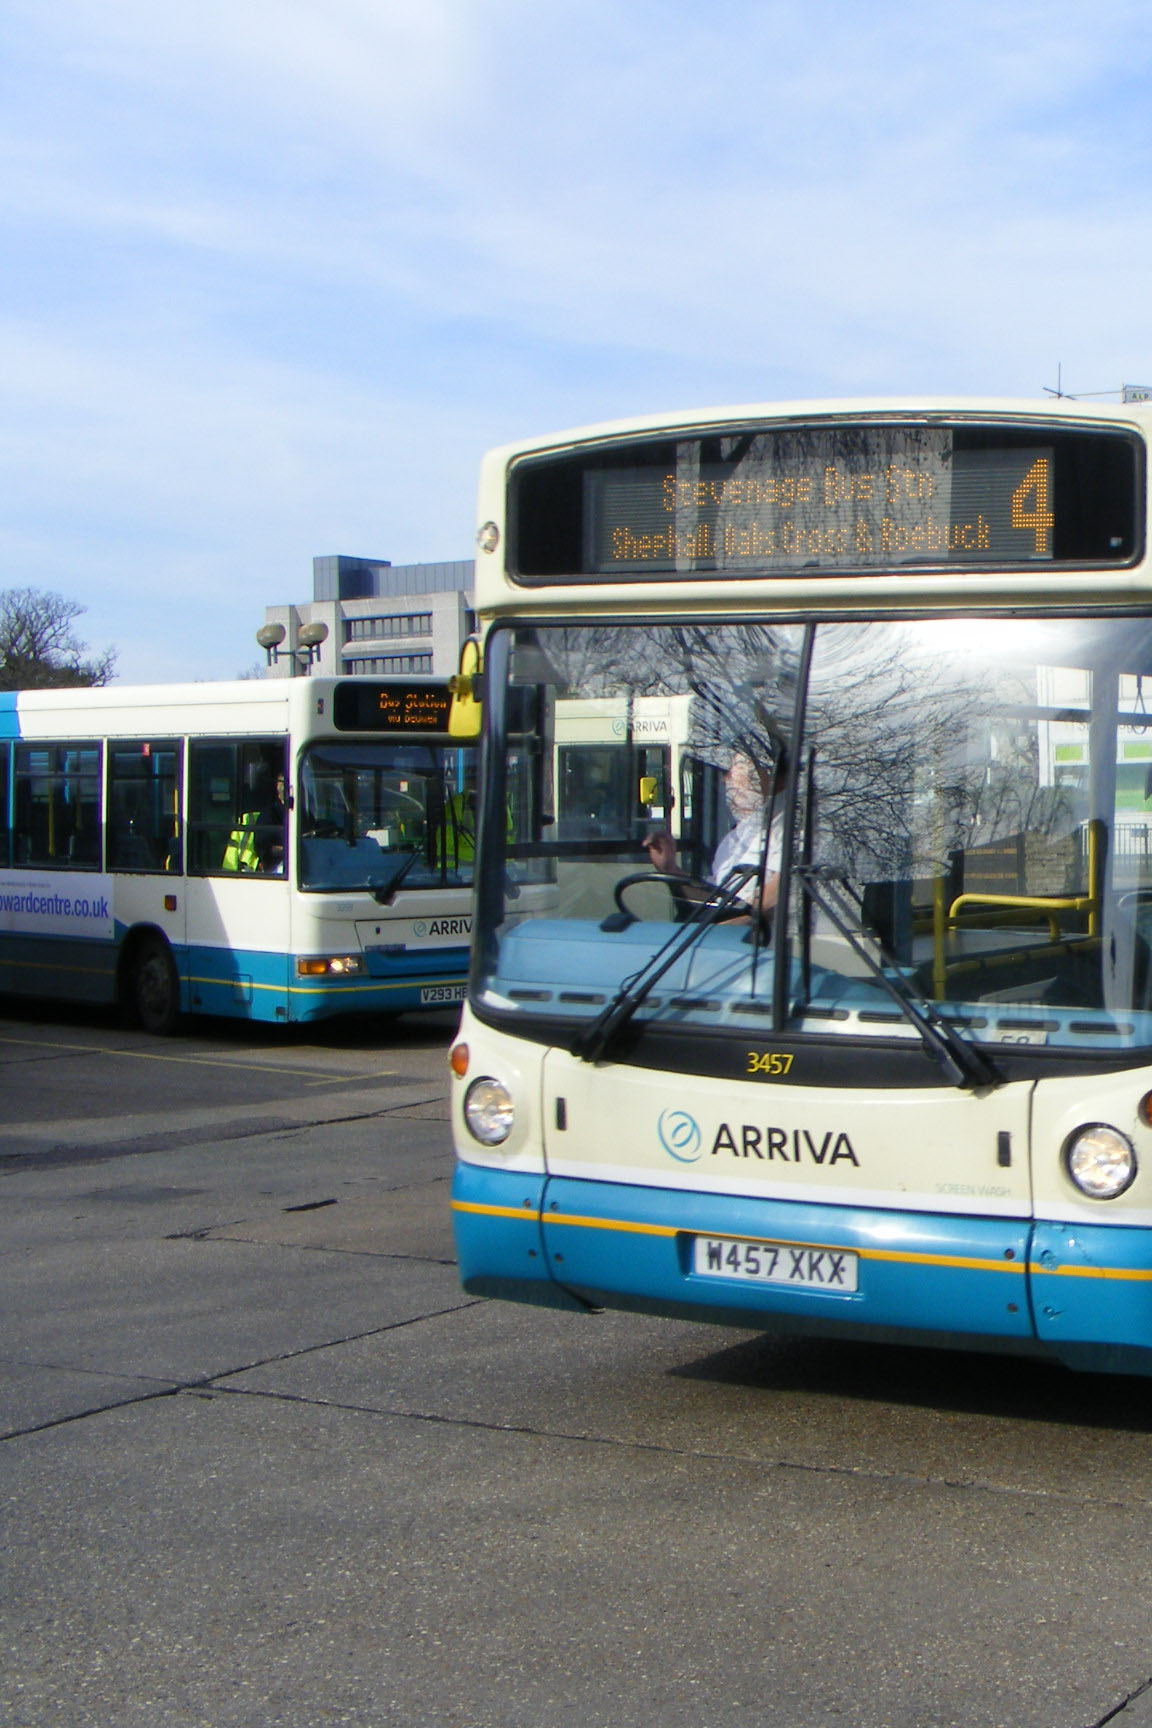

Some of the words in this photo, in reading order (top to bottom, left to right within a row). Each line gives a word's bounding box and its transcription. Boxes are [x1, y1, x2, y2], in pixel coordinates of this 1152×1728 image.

[662, 474, 813, 512] Stevenage
[823, 466, 874, 505] Bus
[885, 463, 933, 504] Stn
[1012, 458, 1055, 552] 4
[783, 520, 848, 555] Cross
[855, 518, 874, 552] &
[881, 514, 990, 552] Roebuck
[379, 693, 401, 709] Bus
[404, 693, 447, 709] Station
[423, 988, 452, 1001] V293
[746, 1052, 794, 1075] 3457
[711, 1122, 861, 1168] ARRIVA
[707, 1241, 779, 1276] W457
[788, 1250, 846, 1284] XKX
